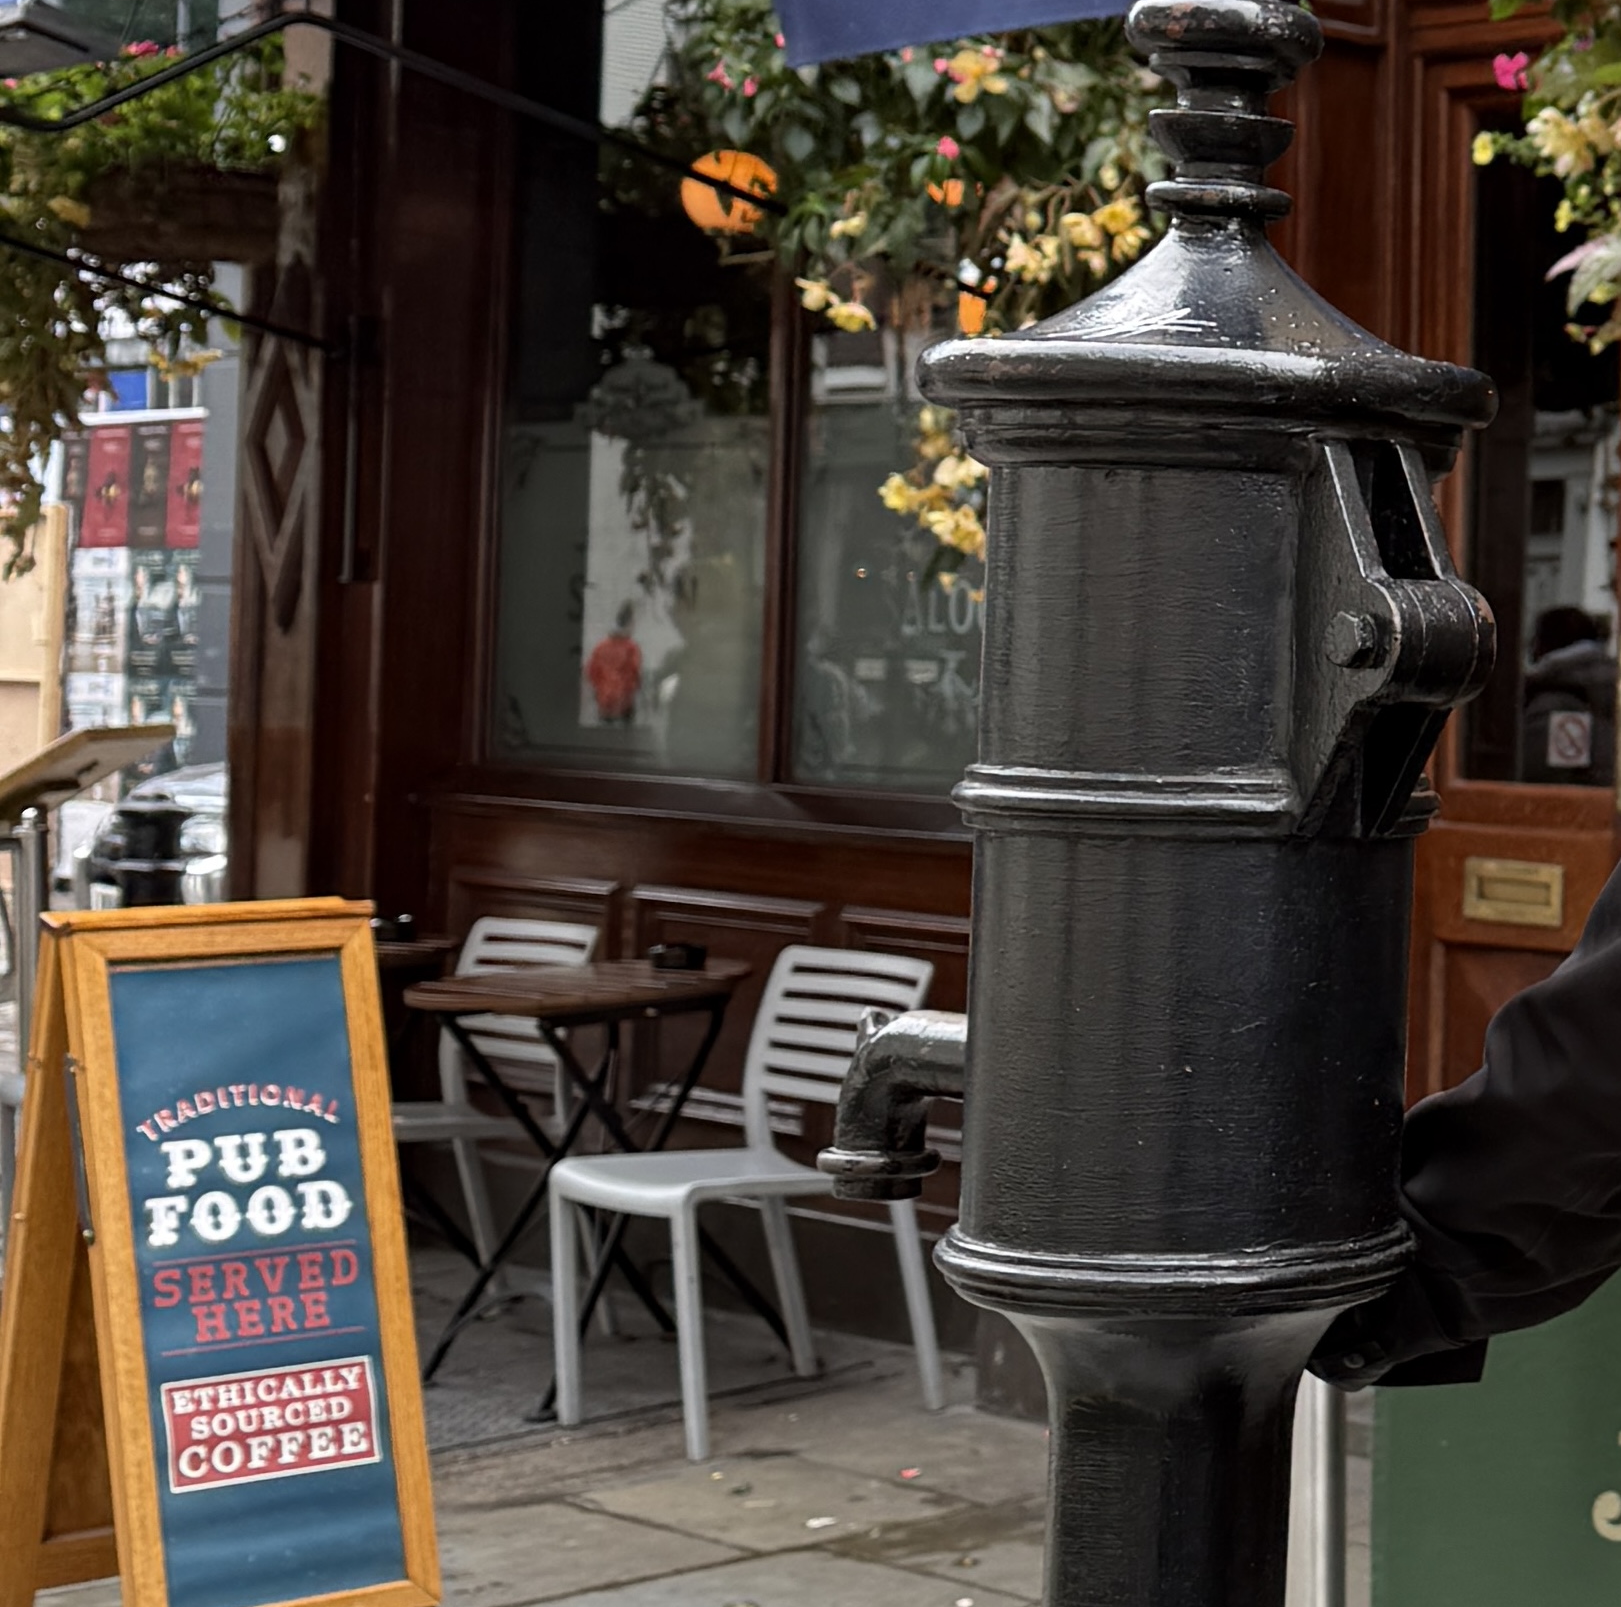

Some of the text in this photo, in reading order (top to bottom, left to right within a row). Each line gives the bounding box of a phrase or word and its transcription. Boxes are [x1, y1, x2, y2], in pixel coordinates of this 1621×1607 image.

[136, 1084, 339, 1140] TRADITIONAL
[161, 1128, 327, 1189] PUB
[144, 1179, 353, 1246] FOOD
[153, 1249, 358, 1308] SERVED
[191, 1292, 330, 1342] HERE
[170, 1366, 362, 1414] ETHICALLY
[190, 1395, 353, 1441] SOURCED
[178, 1421, 370, 1478] COFFEE
